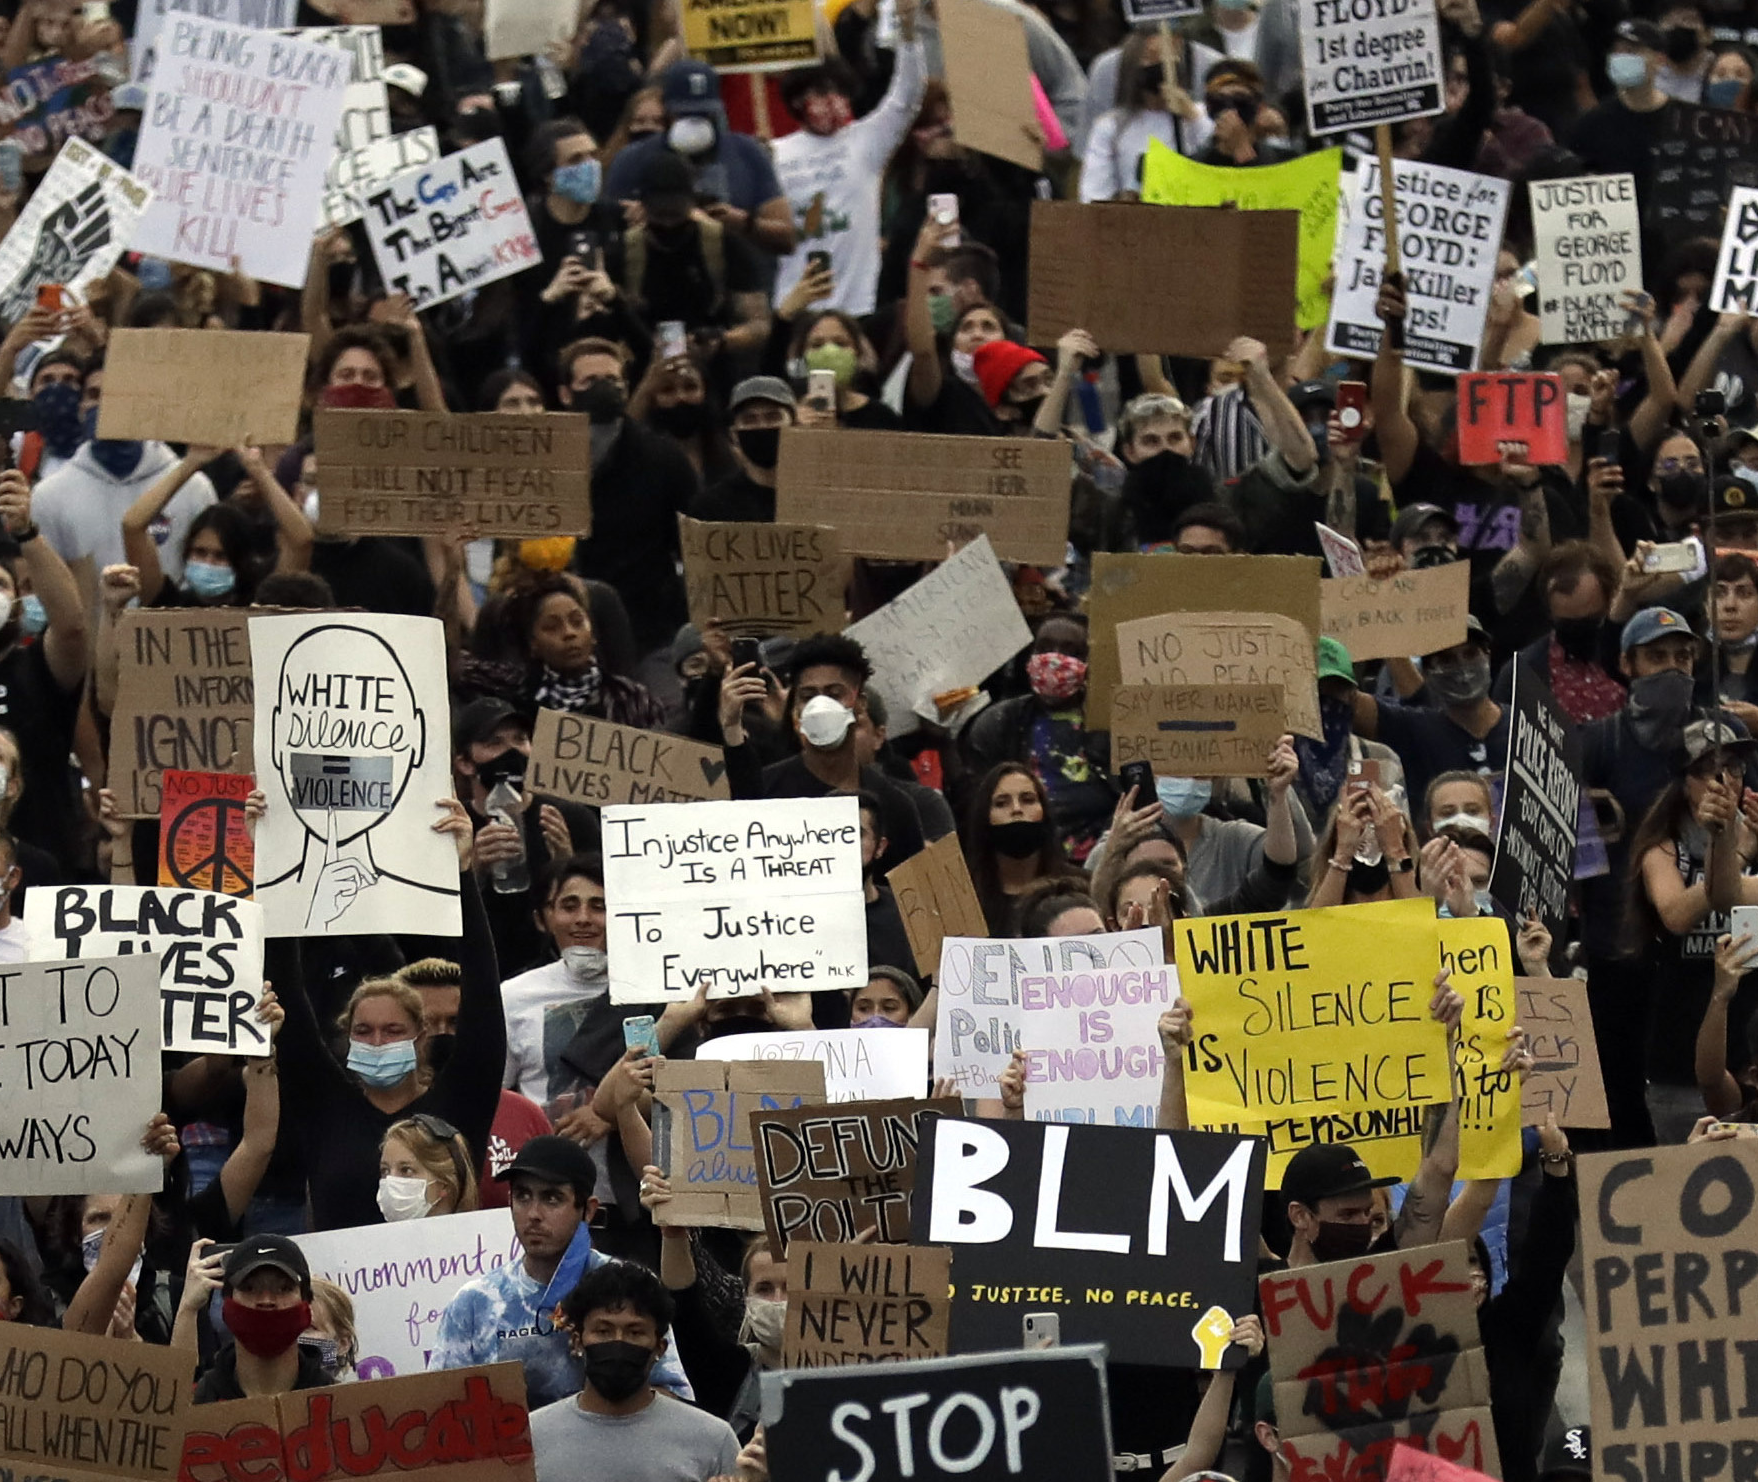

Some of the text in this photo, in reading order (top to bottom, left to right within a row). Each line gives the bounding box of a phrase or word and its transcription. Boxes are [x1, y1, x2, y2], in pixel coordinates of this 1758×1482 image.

[172, 28, 342, 89] BEING BLACK
[1315, 28, 1427, 65] 1st degree
[1332, 53, 1436, 90] Chauvin!
[462, 158, 500, 186] Are
[1538, 181, 1633, 211] JUSTICE
[1568, 210, 1606, 231] FOR
[1555, 232, 1633, 259] GEORGE
[1562, 257, 1627, 287] FLOYD
[1465, 377, 1557, 426] FTP
[358, 420, 552, 454] OUR CHILDREN
[351, 464, 553, 498] WILL NOT FEAR
[285, 675, 394, 718] WHITE
[555, 717, 674, 777] BLACK
[293, 777, 392, 810] VIOLENCE
[746, 819, 856, 860] Anywhere
[55, 887, 243, 940] BLACK
[705, 907, 816, 939] Justice
[1188, 921, 1309, 974] WHITE
[1022, 970, 1168, 1011] ENOUGH
[1243, 982, 1416, 1035] SILENCE
[1078, 1012, 1114, 1043] IS
[27, 1030, 140, 1091] TODAY
[1188, 1036, 1431, 1108] IS VIOLENCE
[928, 1119, 1257, 1264] BLM
[971, 1284, 1200, 1310] JUSTICE. NO PEACE.
[798, 1300, 933, 1346] NEVER
